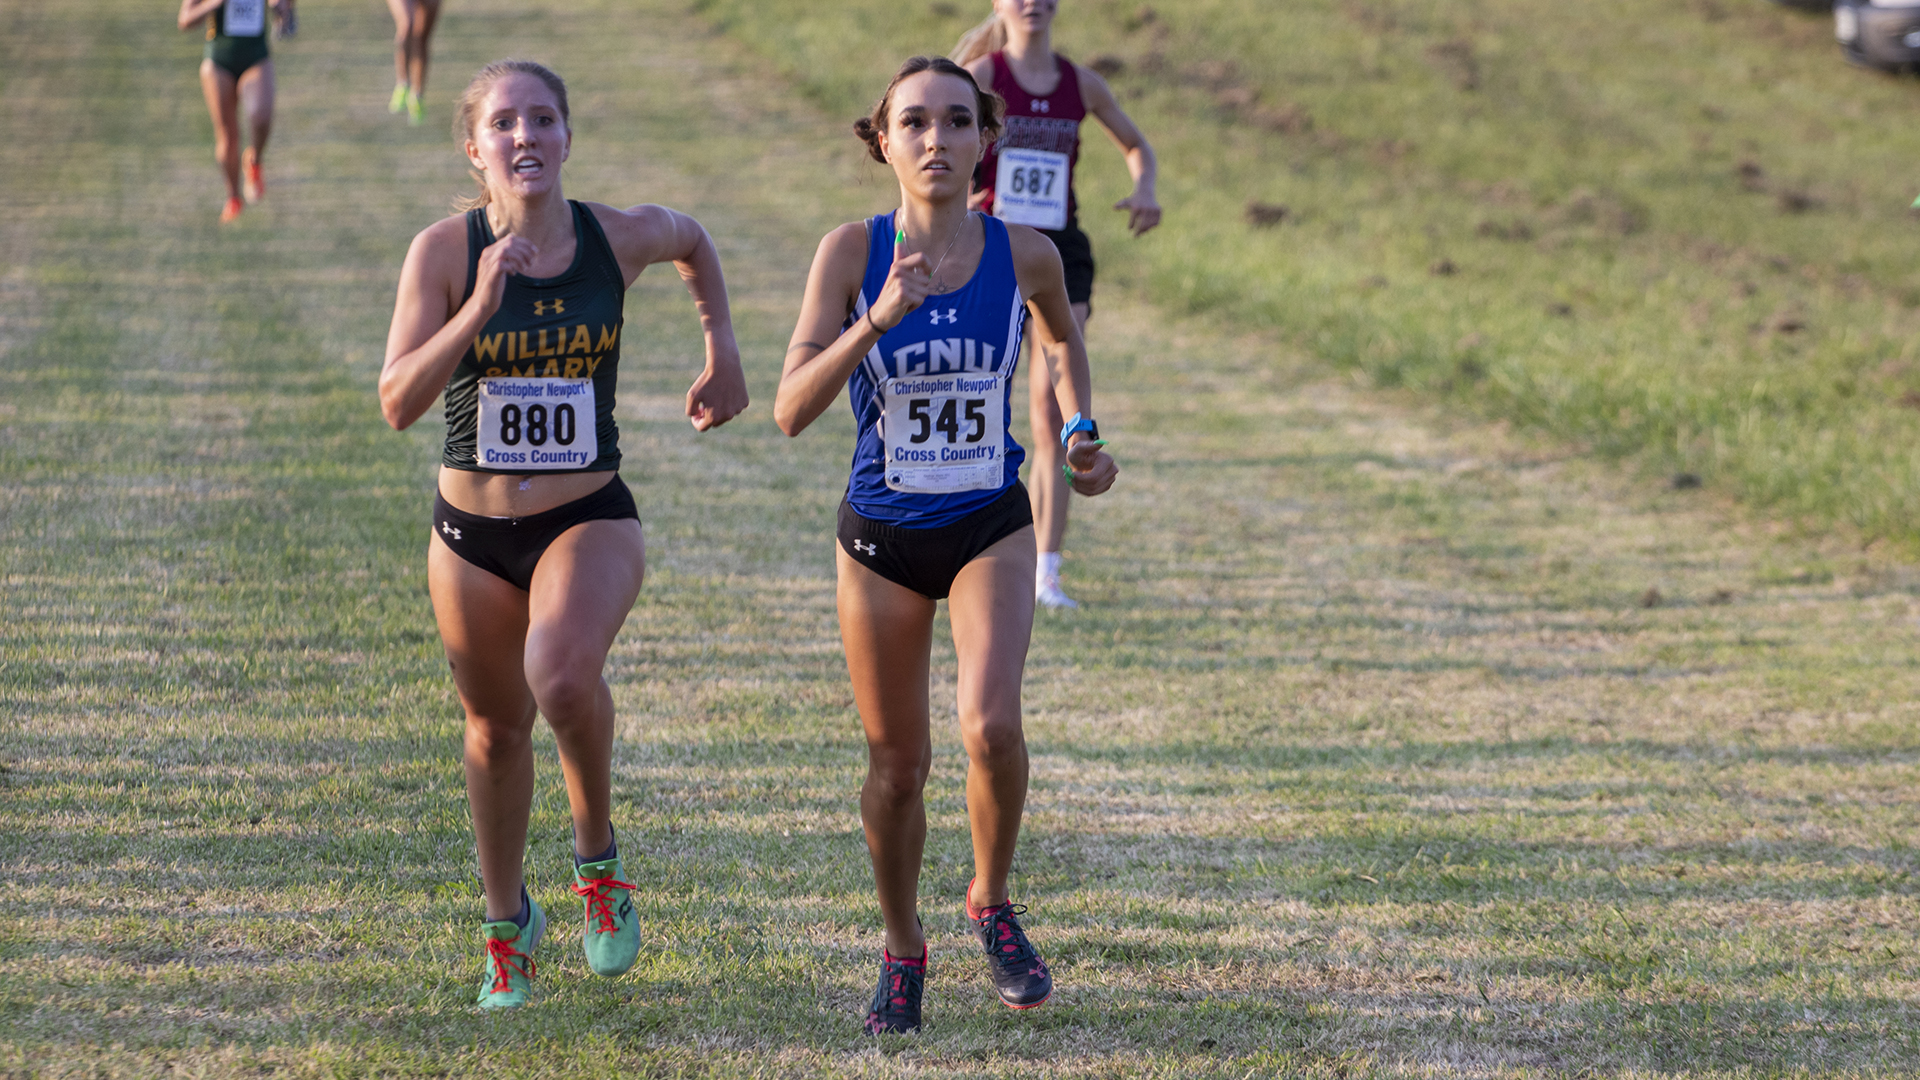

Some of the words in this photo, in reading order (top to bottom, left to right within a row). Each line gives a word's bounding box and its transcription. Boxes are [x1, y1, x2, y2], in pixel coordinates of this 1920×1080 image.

[1012, 167, 1056, 195] 687
[474, 323, 618, 363] WILLIAM
[510, 356, 603, 379] MARY
[893, 337, 996, 377] CNU
[487, 381, 544, 399] Christopher
[546, 381, 586, 398] Newport
[895, 379, 953, 395] Christopher
[956, 377, 998, 394] Newport
[500, 403, 575, 446] 880
[908, 398, 986, 444] 545
[485, 448, 526, 463] Cross
[530, 449, 588, 465] Country
[894, 446, 936, 462] Cross
[940, 445, 996, 462] Country
